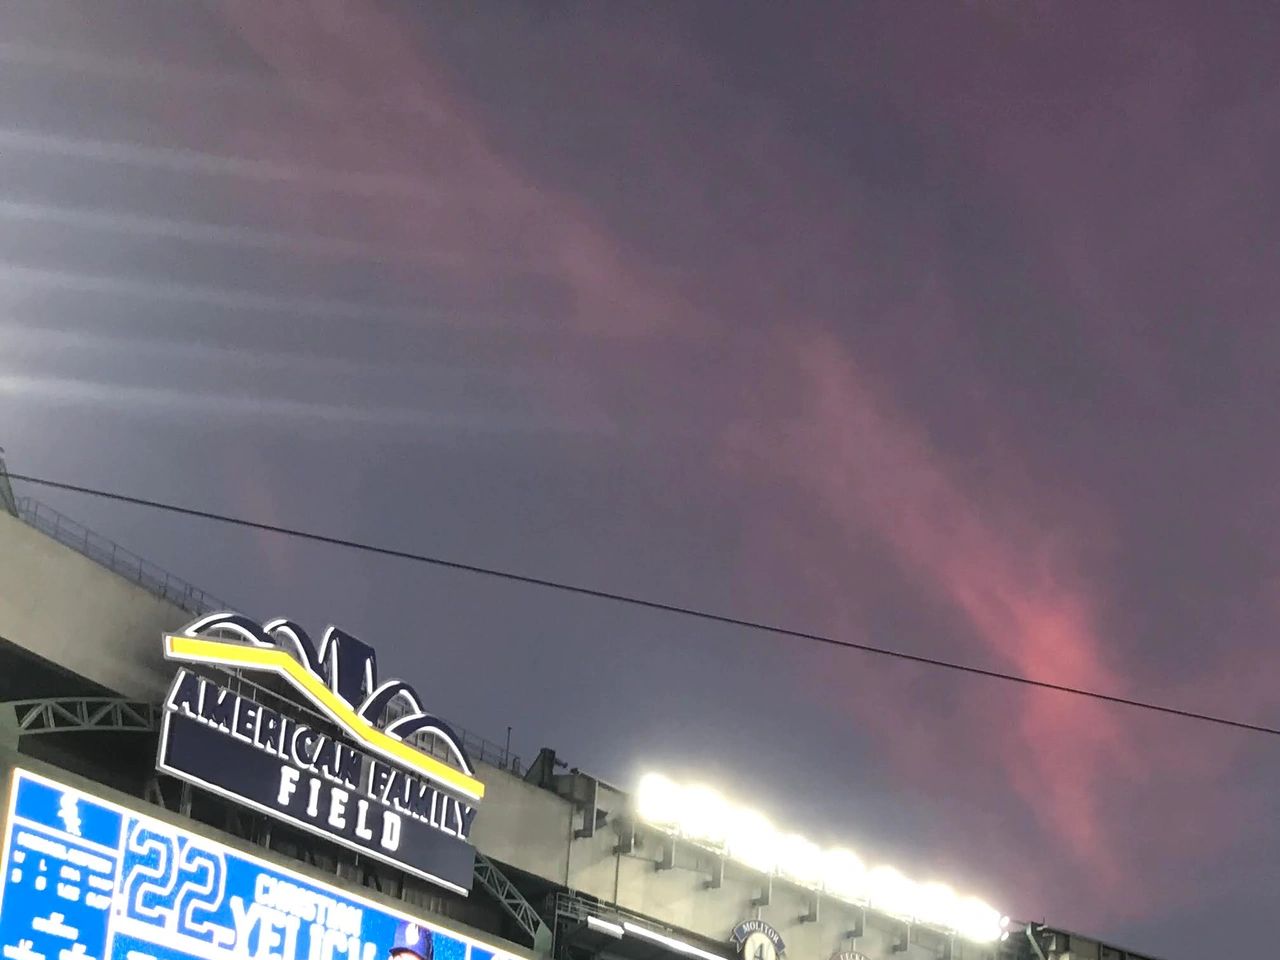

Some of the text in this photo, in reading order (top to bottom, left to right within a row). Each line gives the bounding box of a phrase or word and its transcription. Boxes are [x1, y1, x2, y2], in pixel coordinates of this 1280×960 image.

[166, 669, 478, 839] AMERICAN FAMILY
[276, 765, 402, 852] FIELD
[123, 819, 237, 950] 22
[741, 922, 780, 945] MOLITOR
